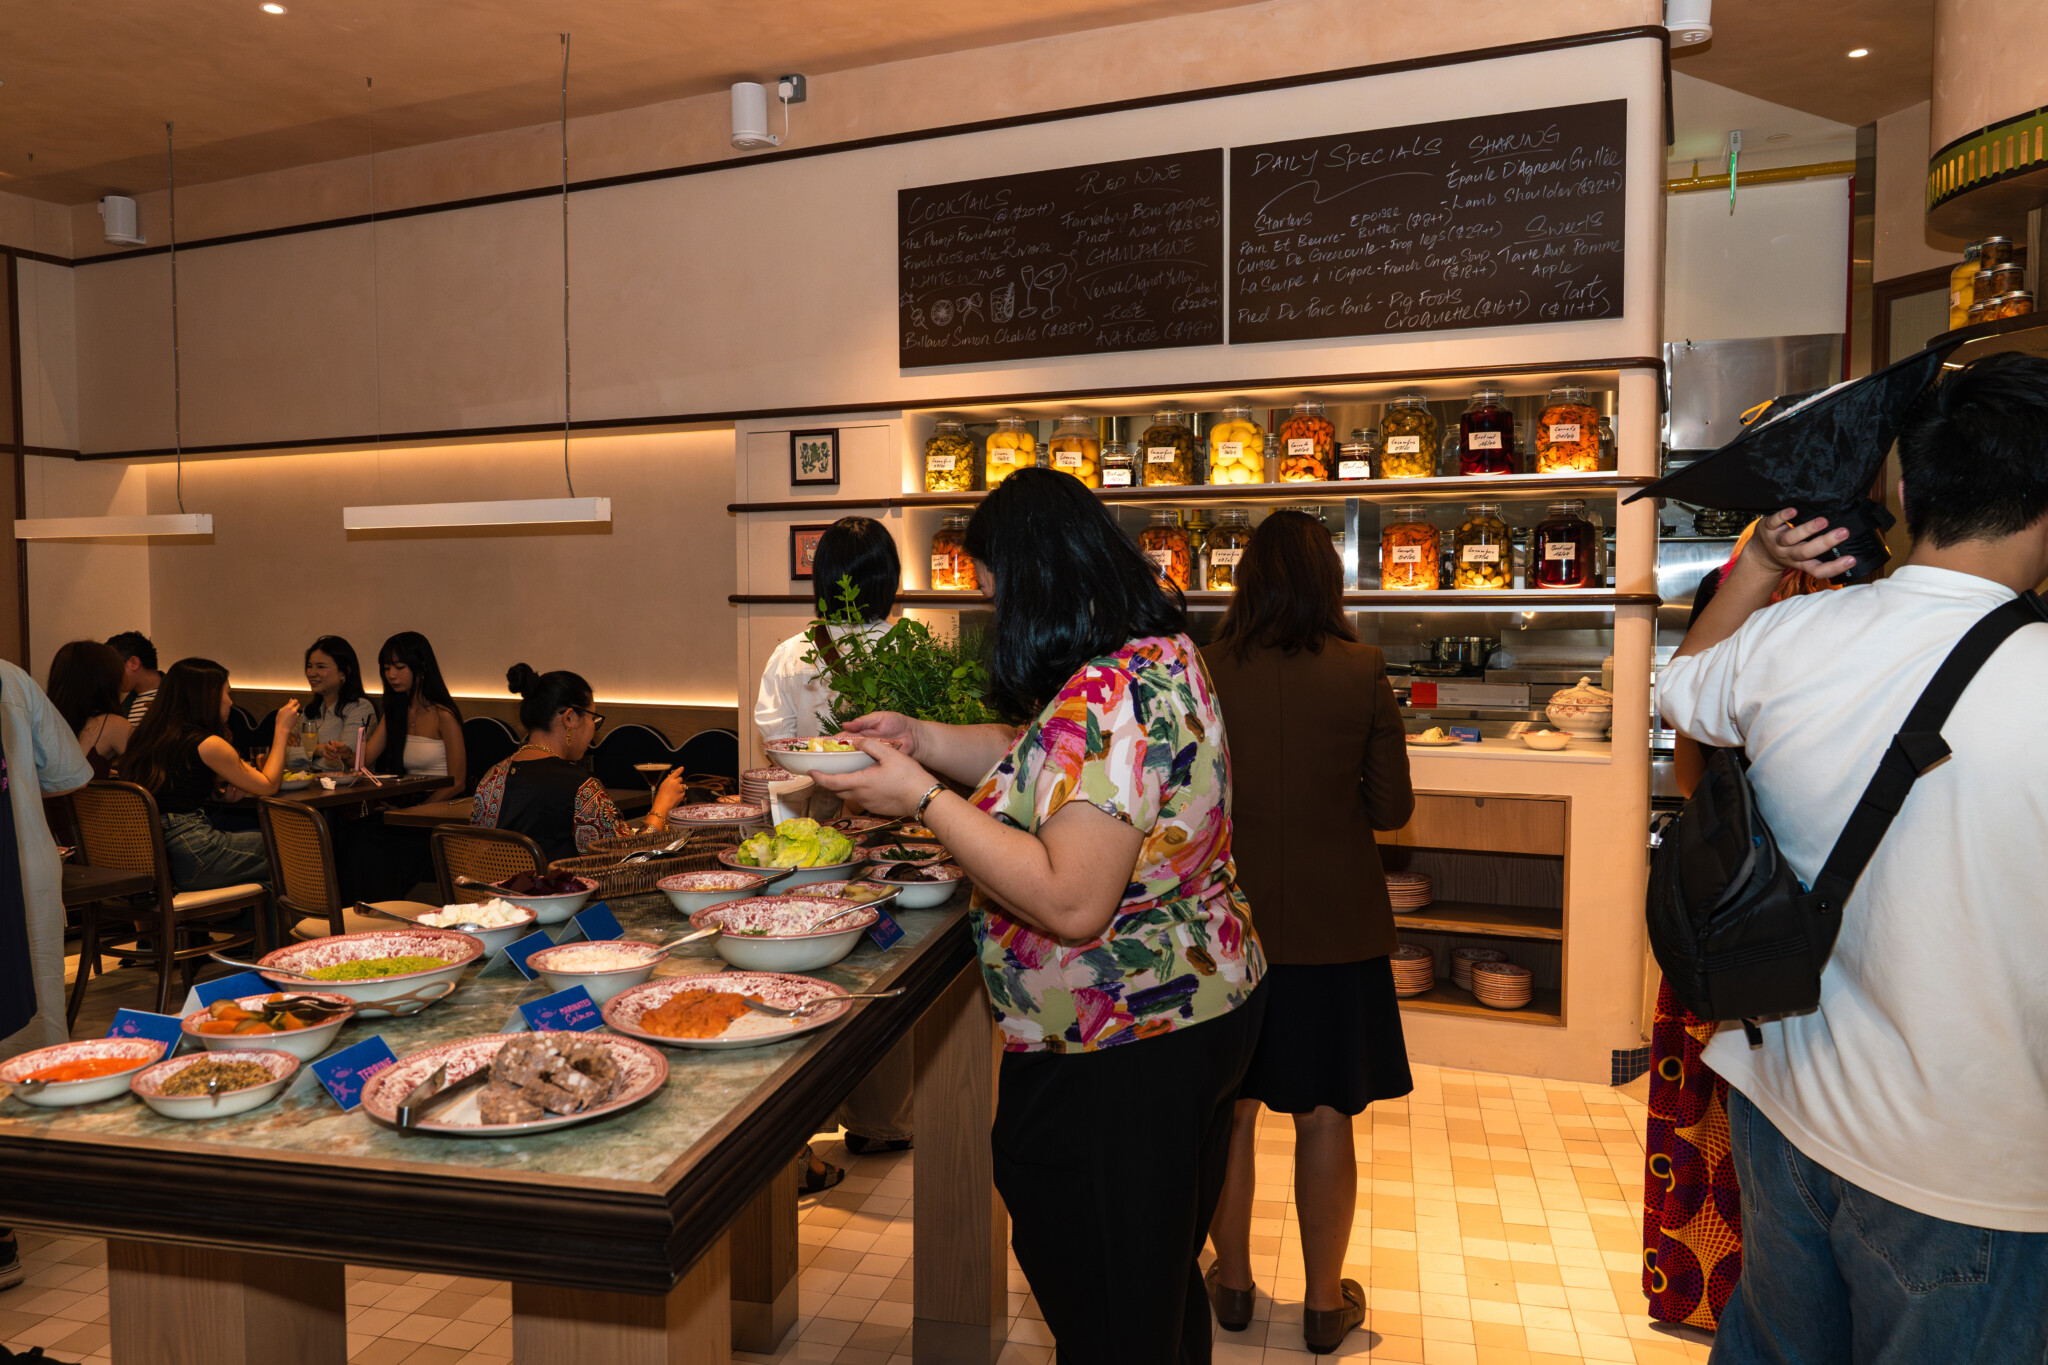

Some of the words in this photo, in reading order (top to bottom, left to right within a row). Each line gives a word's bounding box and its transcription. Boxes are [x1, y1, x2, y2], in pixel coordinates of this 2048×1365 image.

[1468, 124, 1560, 158] SHARING
[1250, 149, 1319, 177] DAILY
[1323, 136, 1443, 173] SPECIALS
[1075, 170, 1127, 196] RED
[1133, 163, 1182, 185] WINE
[1452, 193, 1498, 210] Lamb
[1503, 181, 1578, 203] Shoulder
[1254, 211, 1314, 232] Starters
[1072, 229, 1115, 247] Pinot
[1239, 240, 1268, 256] Pain
[1358, 223, 1403, 239] Butter
[1237, 257, 1279, 275] Cuisse
[1496, 245, 1541, 265] Tarte
[1240, 277, 1259, 295] La
[1459, 247, 1491, 267] Soup
[1553, 273, 1607, 300] Tart
